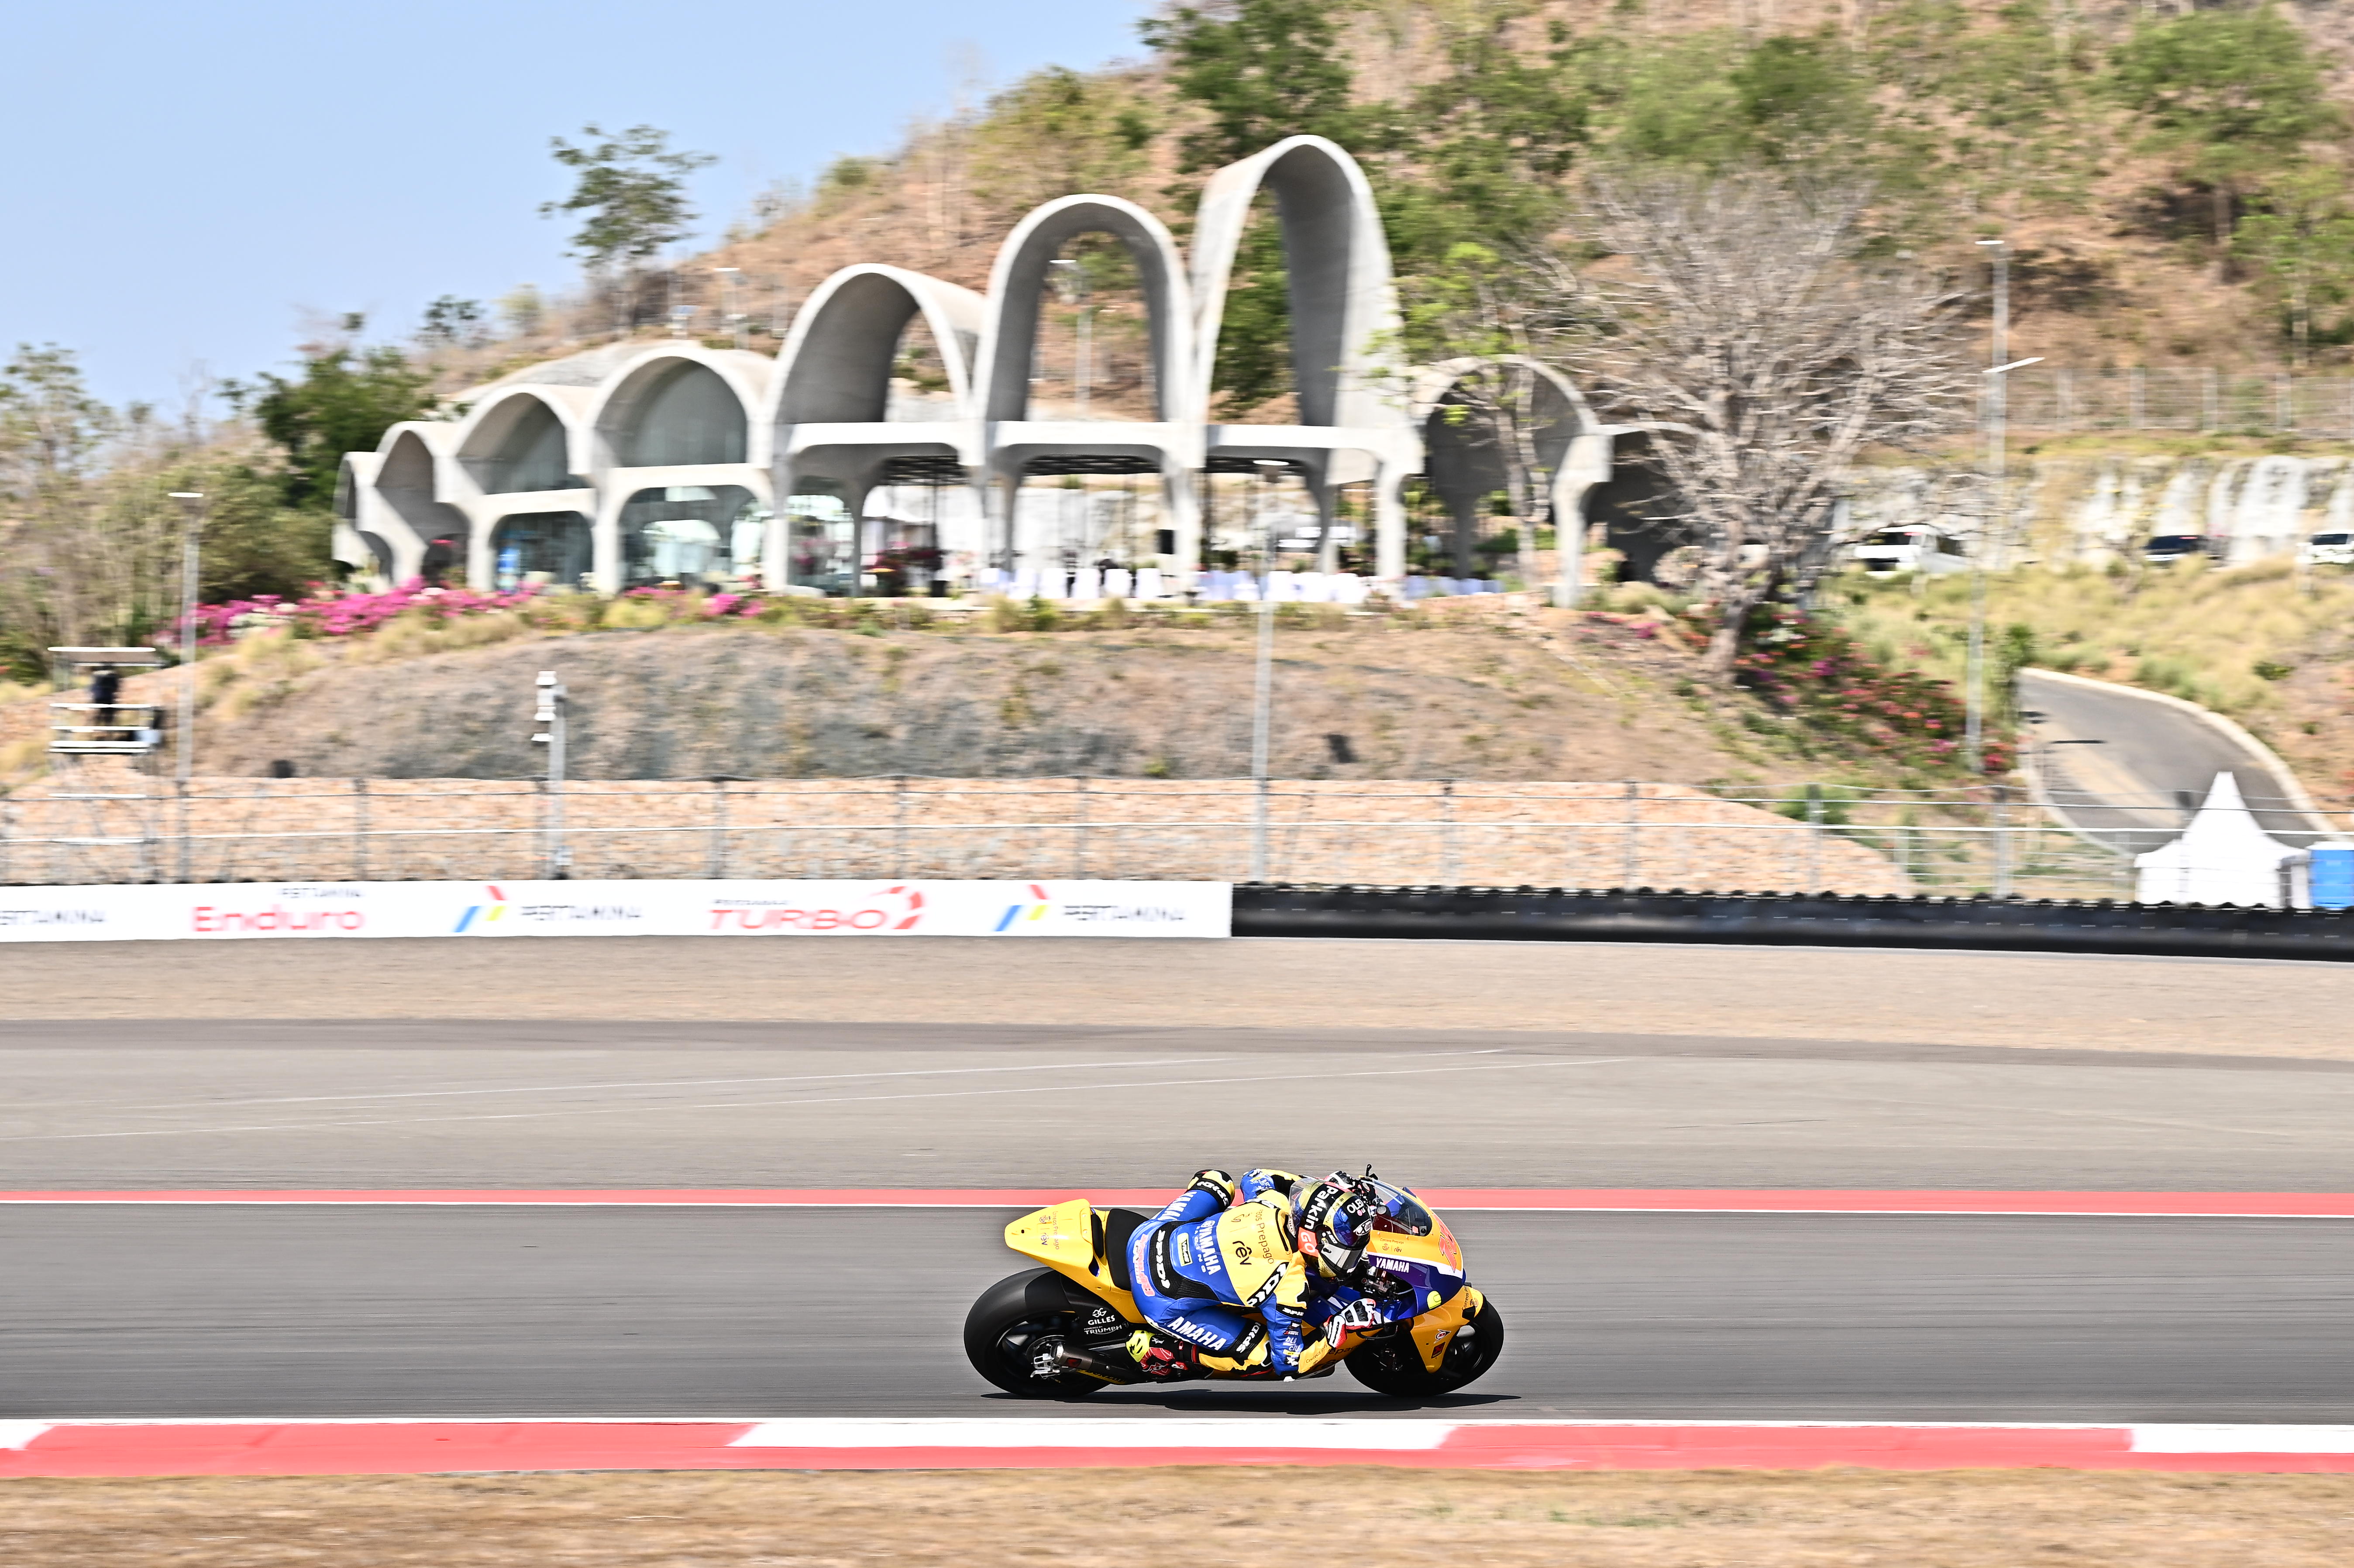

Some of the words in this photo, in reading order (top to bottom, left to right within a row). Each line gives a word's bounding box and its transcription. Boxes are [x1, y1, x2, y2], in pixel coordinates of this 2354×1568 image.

[193, 904, 364, 932] Enduro
[710, 909, 887, 929] TURBO
[1199, 1226, 1221, 1275] YAMAHA
[1232, 1241, 1252, 1265] rêv
[1256, 1223, 1274, 1264] Prepago
[1301, 1232, 1315, 1253] GO
[1376, 1257, 1409, 1273] YAMAHA
[1084, 1325, 1122, 1334] TRIUMPH
[1088, 1315, 1115, 1325] GILLES
[1167, 1316, 1227, 1351] AMAHA
